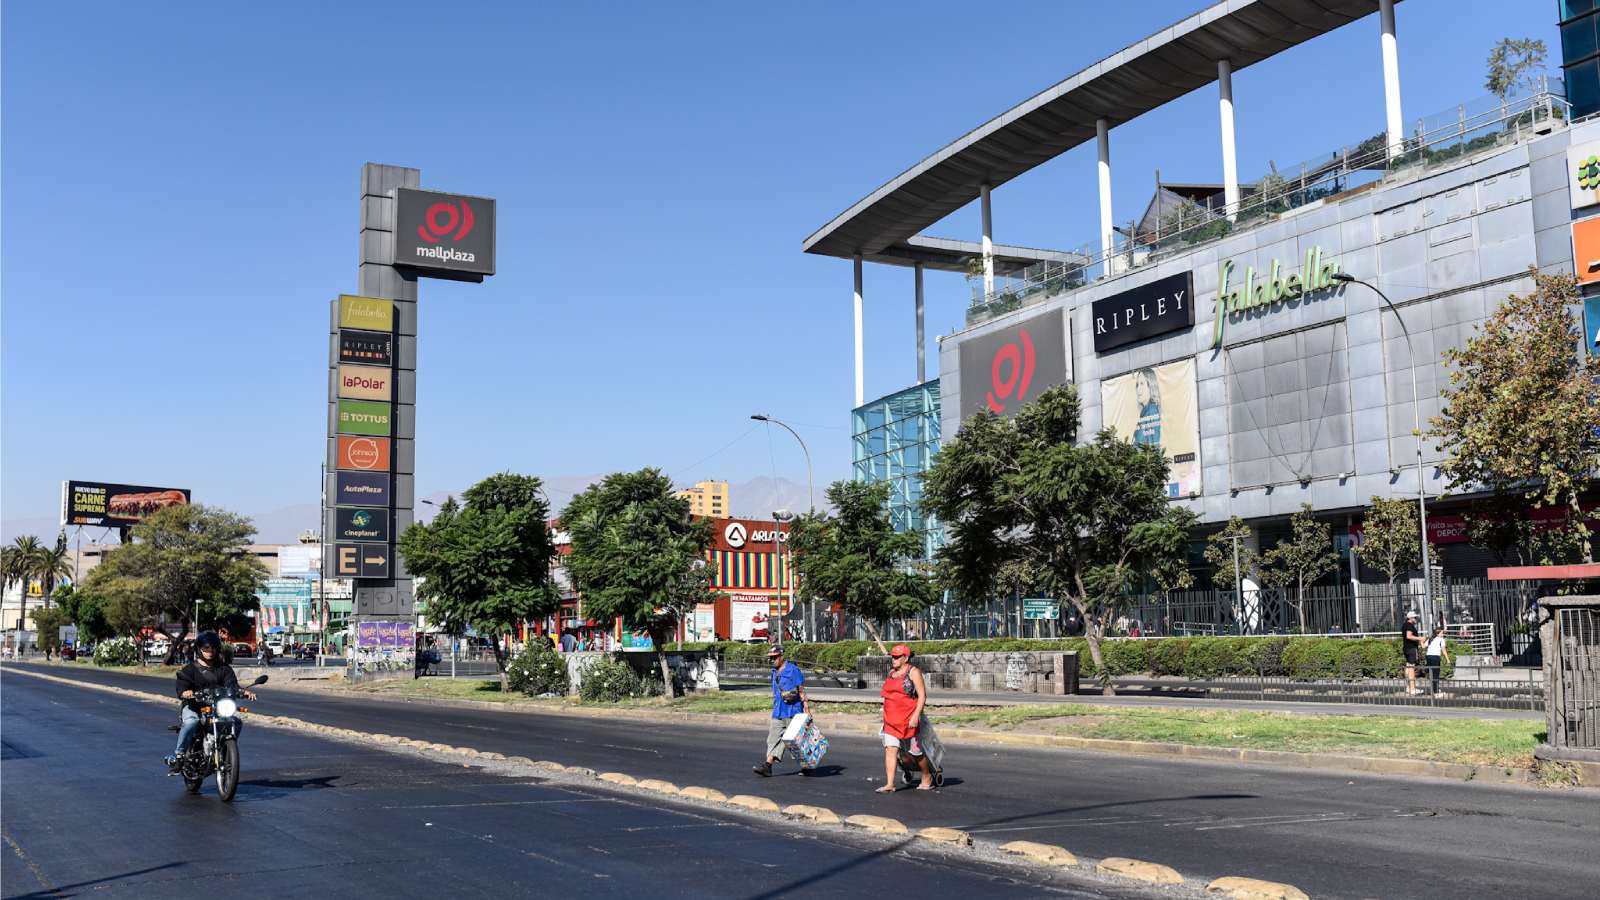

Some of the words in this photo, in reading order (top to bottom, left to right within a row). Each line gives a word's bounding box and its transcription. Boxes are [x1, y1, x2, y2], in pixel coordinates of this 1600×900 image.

[416, 246, 475, 263] mallplaza
[1208, 245, 1341, 350] falabella
[1096, 290, 1185, 335] RIPLEY
[344, 341, 383, 351] RIPLEY
[343, 376, 385, 390] laPolar
[351, 414, 388, 424] TOTTUS
[344, 485, 383, 494] AutoPlaza
[74, 493, 106, 506] CARNE
[74, 504, 106, 513] SUPREMA
[344, 529, 379, 537] cineplanet
[339, 547, 357, 574] E
